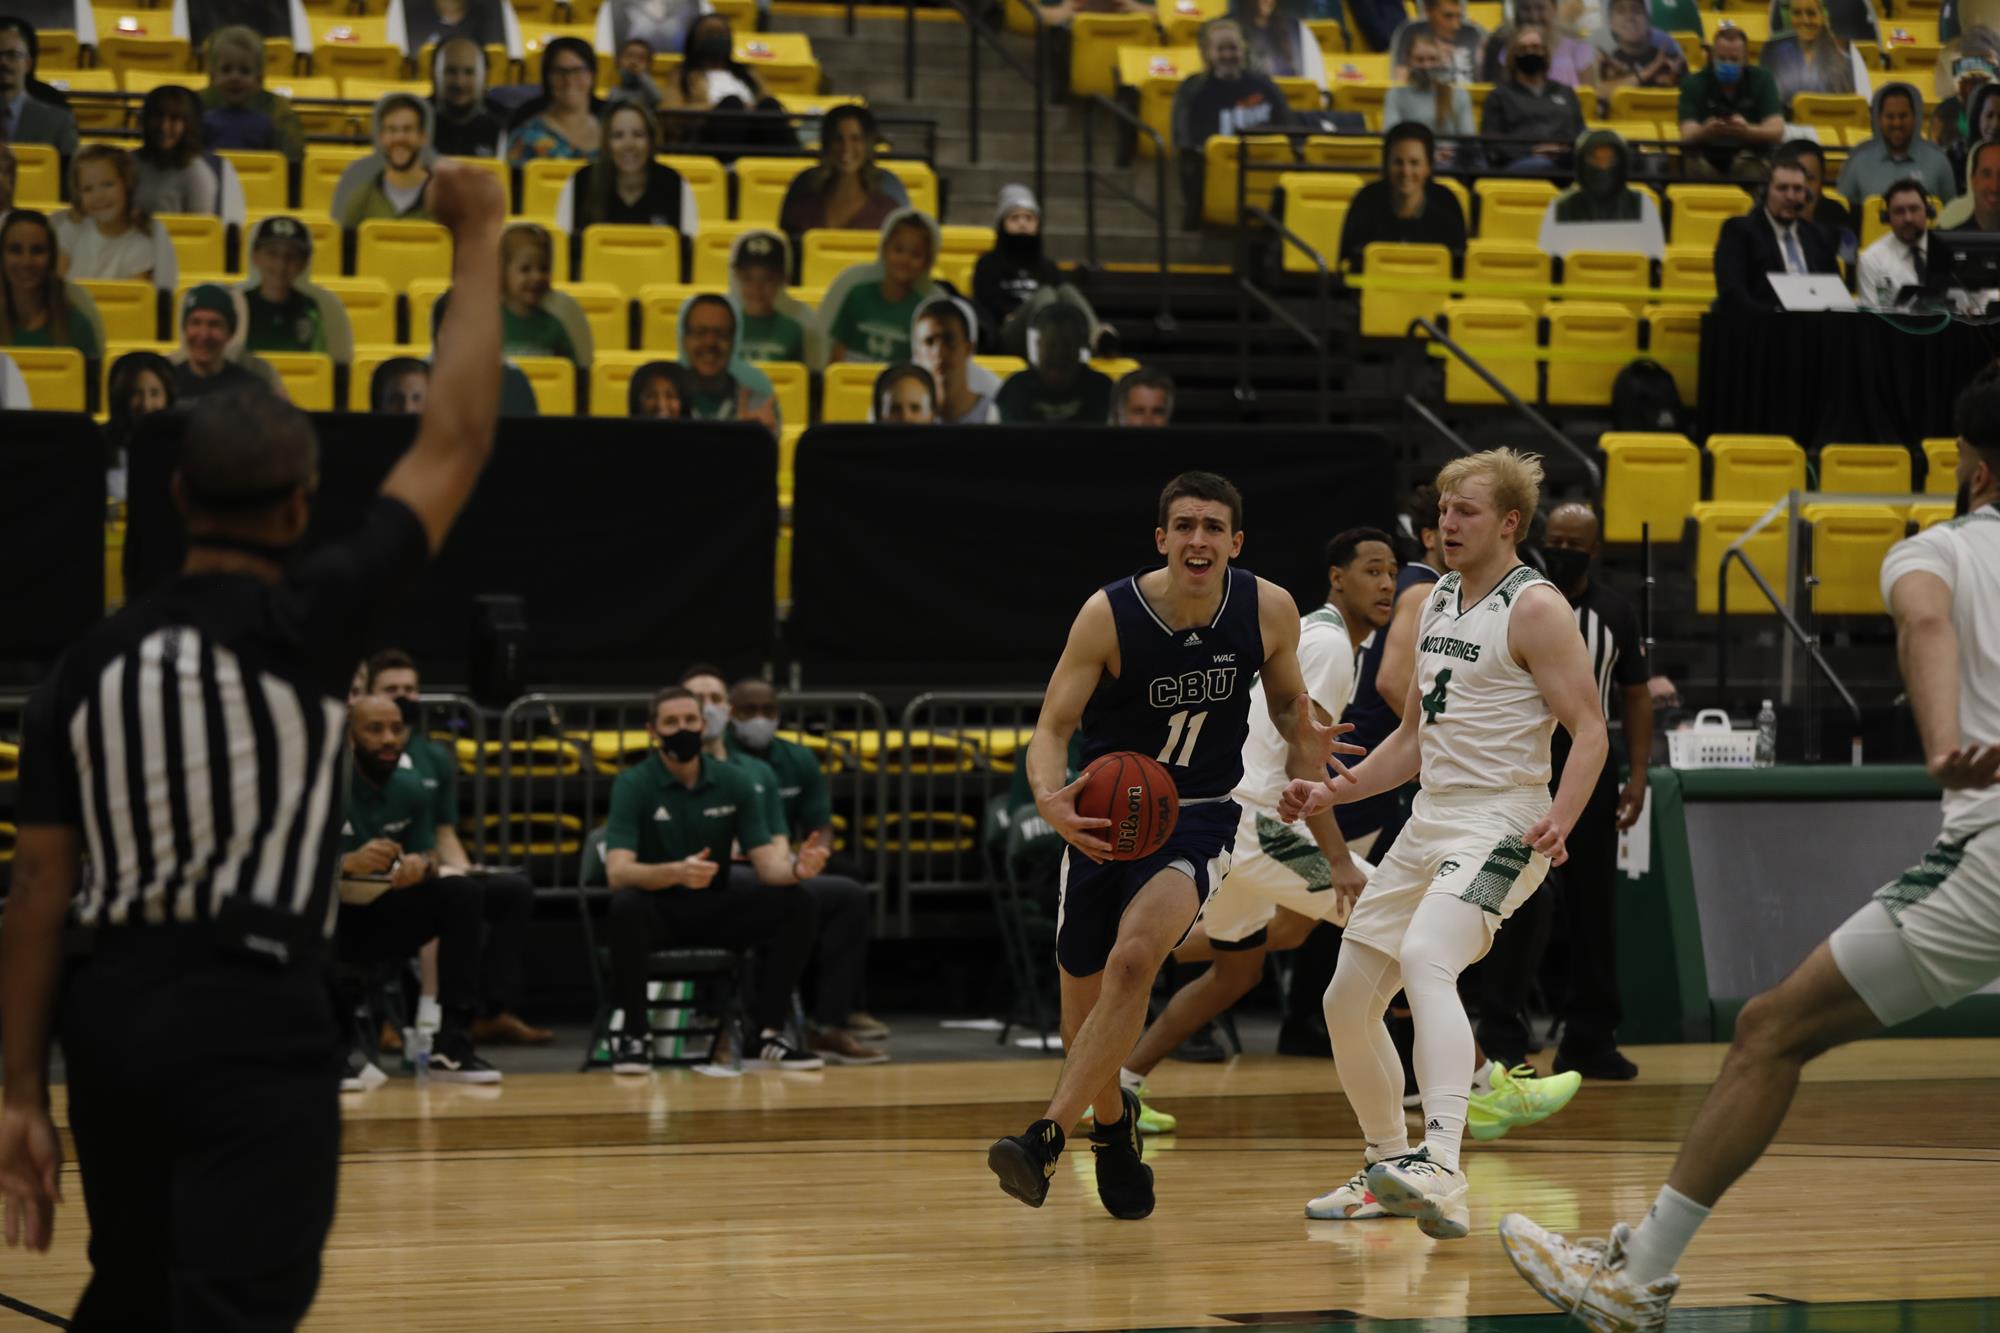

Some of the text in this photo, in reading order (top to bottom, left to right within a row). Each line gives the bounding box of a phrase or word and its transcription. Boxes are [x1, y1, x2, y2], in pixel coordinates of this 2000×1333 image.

[1212, 653, 1236, 663] WAC
[1149, 667, 1237, 708] CBU
[1422, 668, 1452, 724] 4
[1156, 710, 1209, 767] 11
[1117, 786, 1142, 853] Wilson
